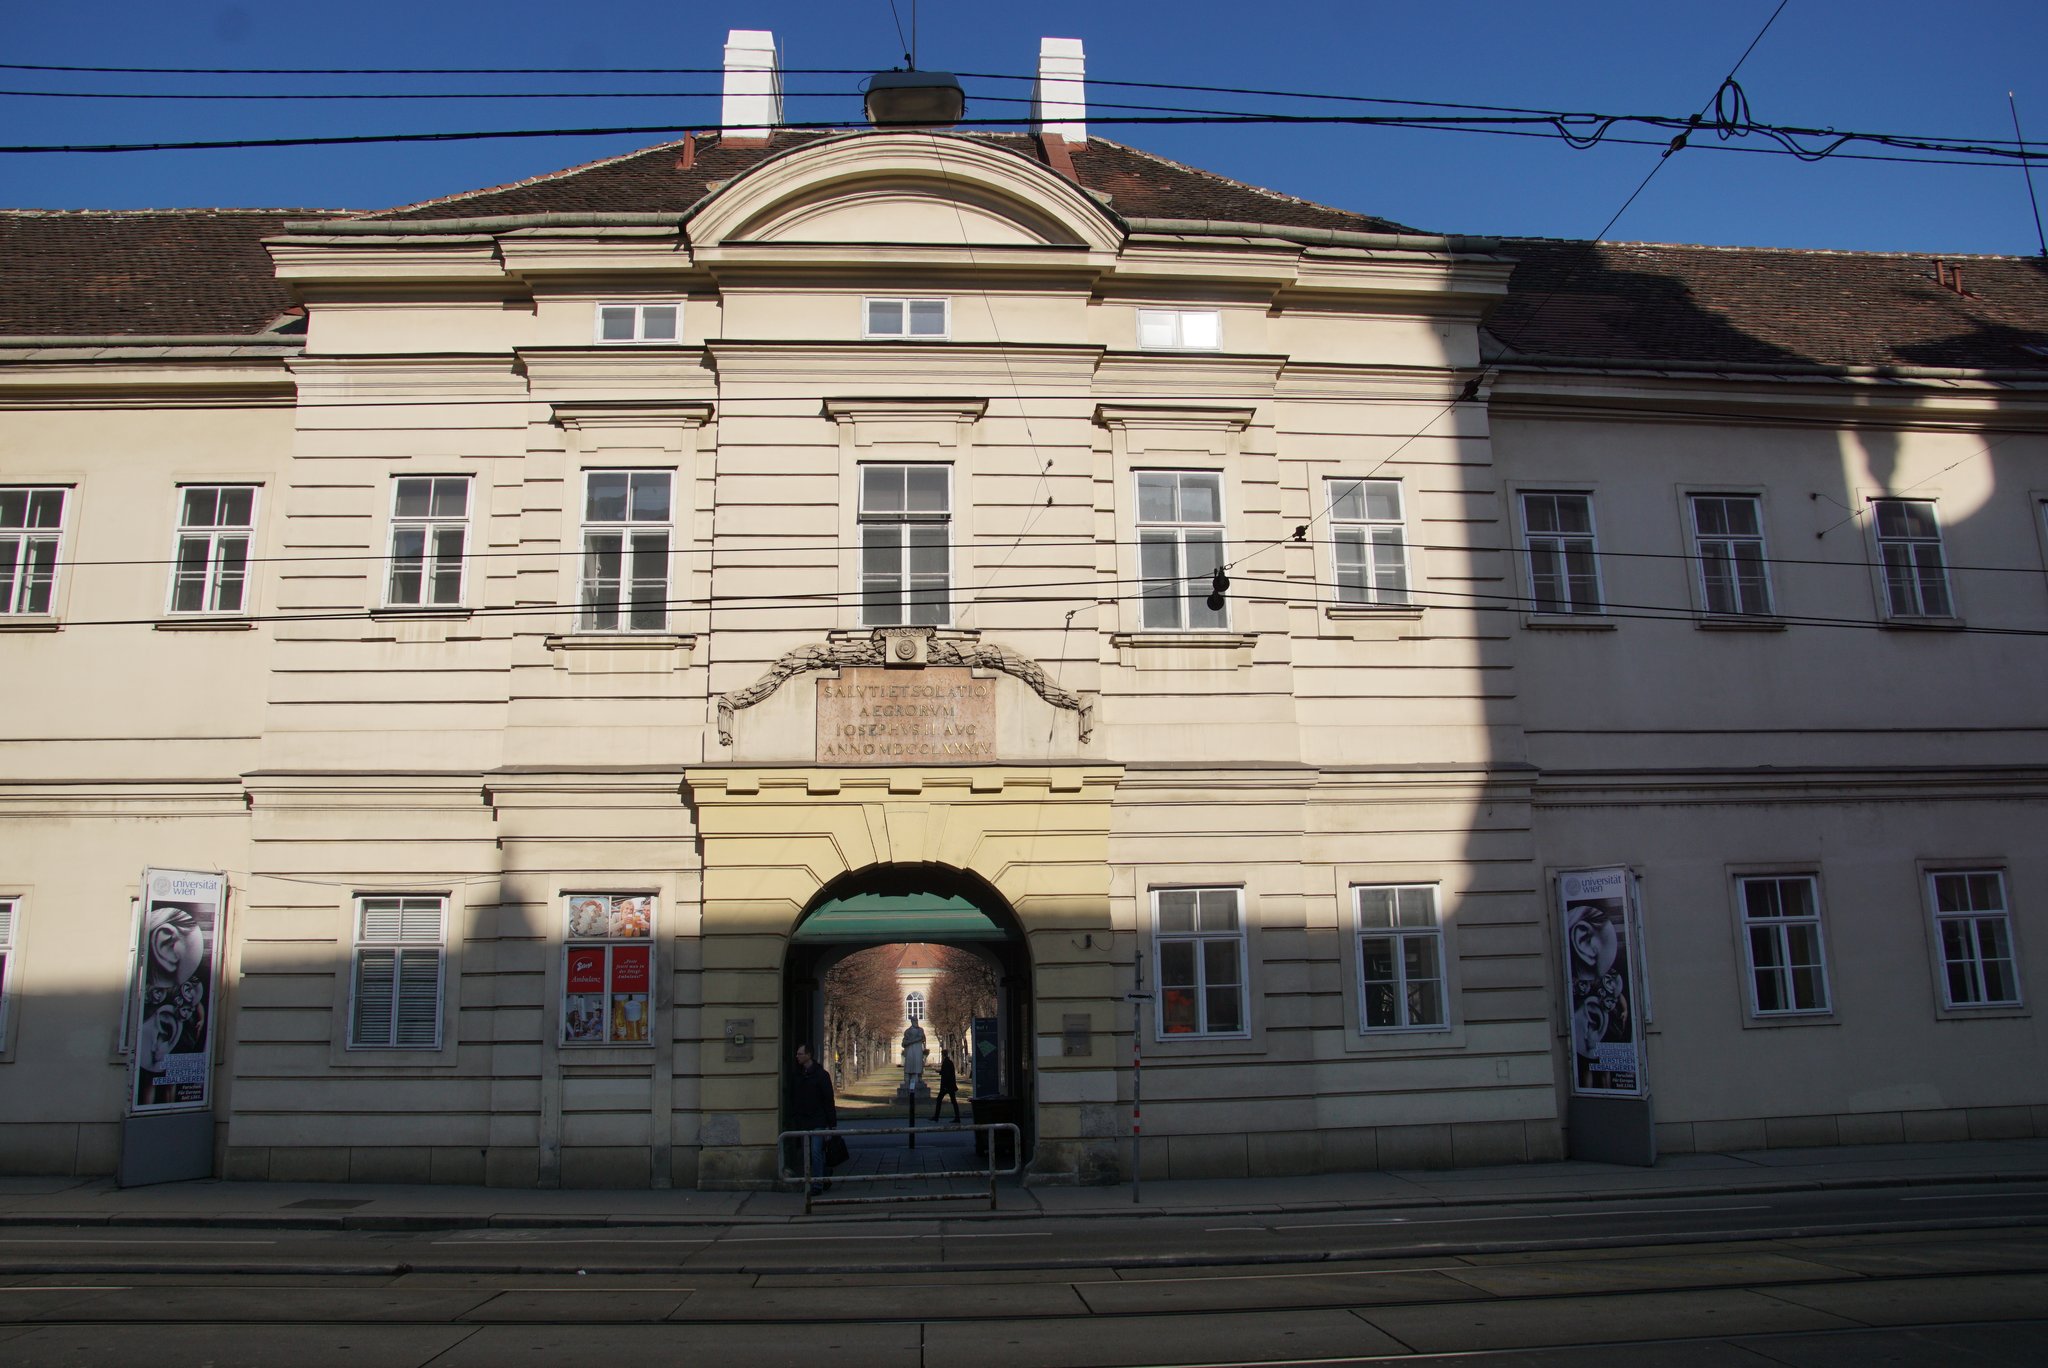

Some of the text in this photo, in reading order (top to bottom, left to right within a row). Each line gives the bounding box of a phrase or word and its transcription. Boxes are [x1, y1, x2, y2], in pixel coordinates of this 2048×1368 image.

[824, 685, 988, 698] SALVTI ET SOLATIO
[859, 705, 955, 717] AEGRORVM
[836, 723, 919, 736] IOSEPHVS
[824, 743, 876, 756] ANNO
[172, 878, 217, 890] universität
[1581, 874, 1621, 886] universität
[172, 887, 196, 896] wien
[1582, 885, 1603, 893] wien
